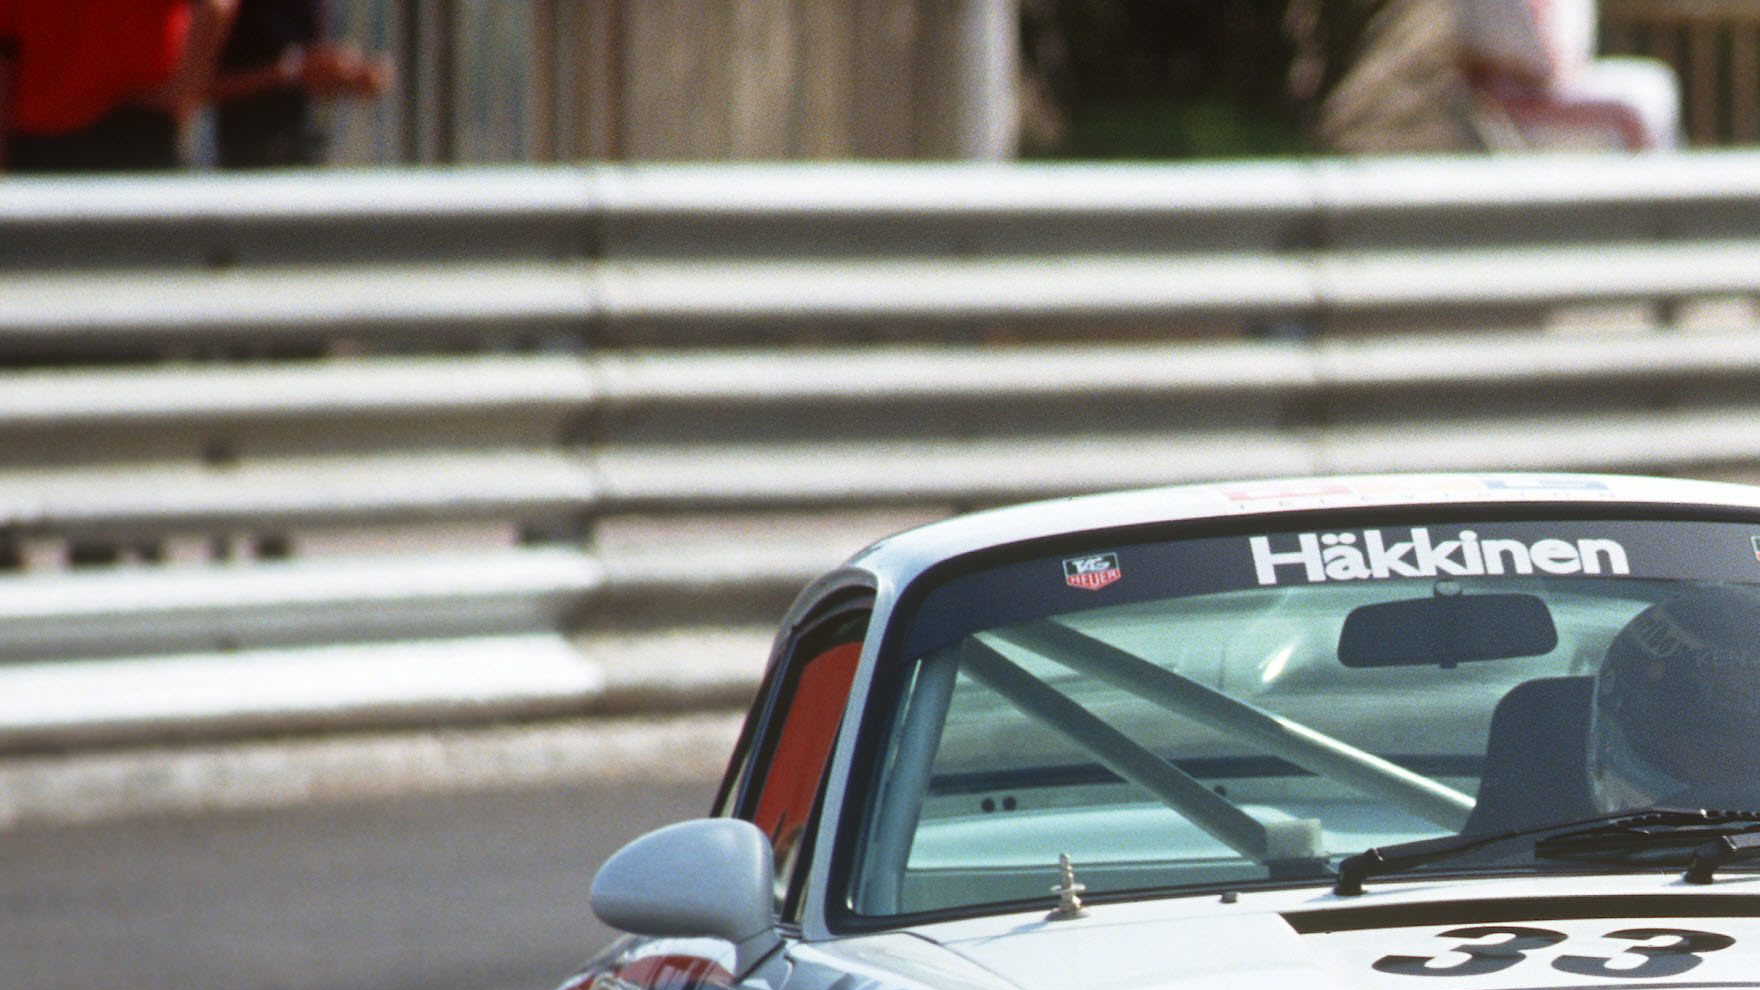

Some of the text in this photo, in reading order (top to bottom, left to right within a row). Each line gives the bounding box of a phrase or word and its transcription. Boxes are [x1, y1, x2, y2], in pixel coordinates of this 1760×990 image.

[1071, 556, 1111, 574] TAG
[1250, 528, 1630, 585] Häkkinen
[1069, 568, 1118, 587] HEUER
[1372, 926, 1736, 978] 33
